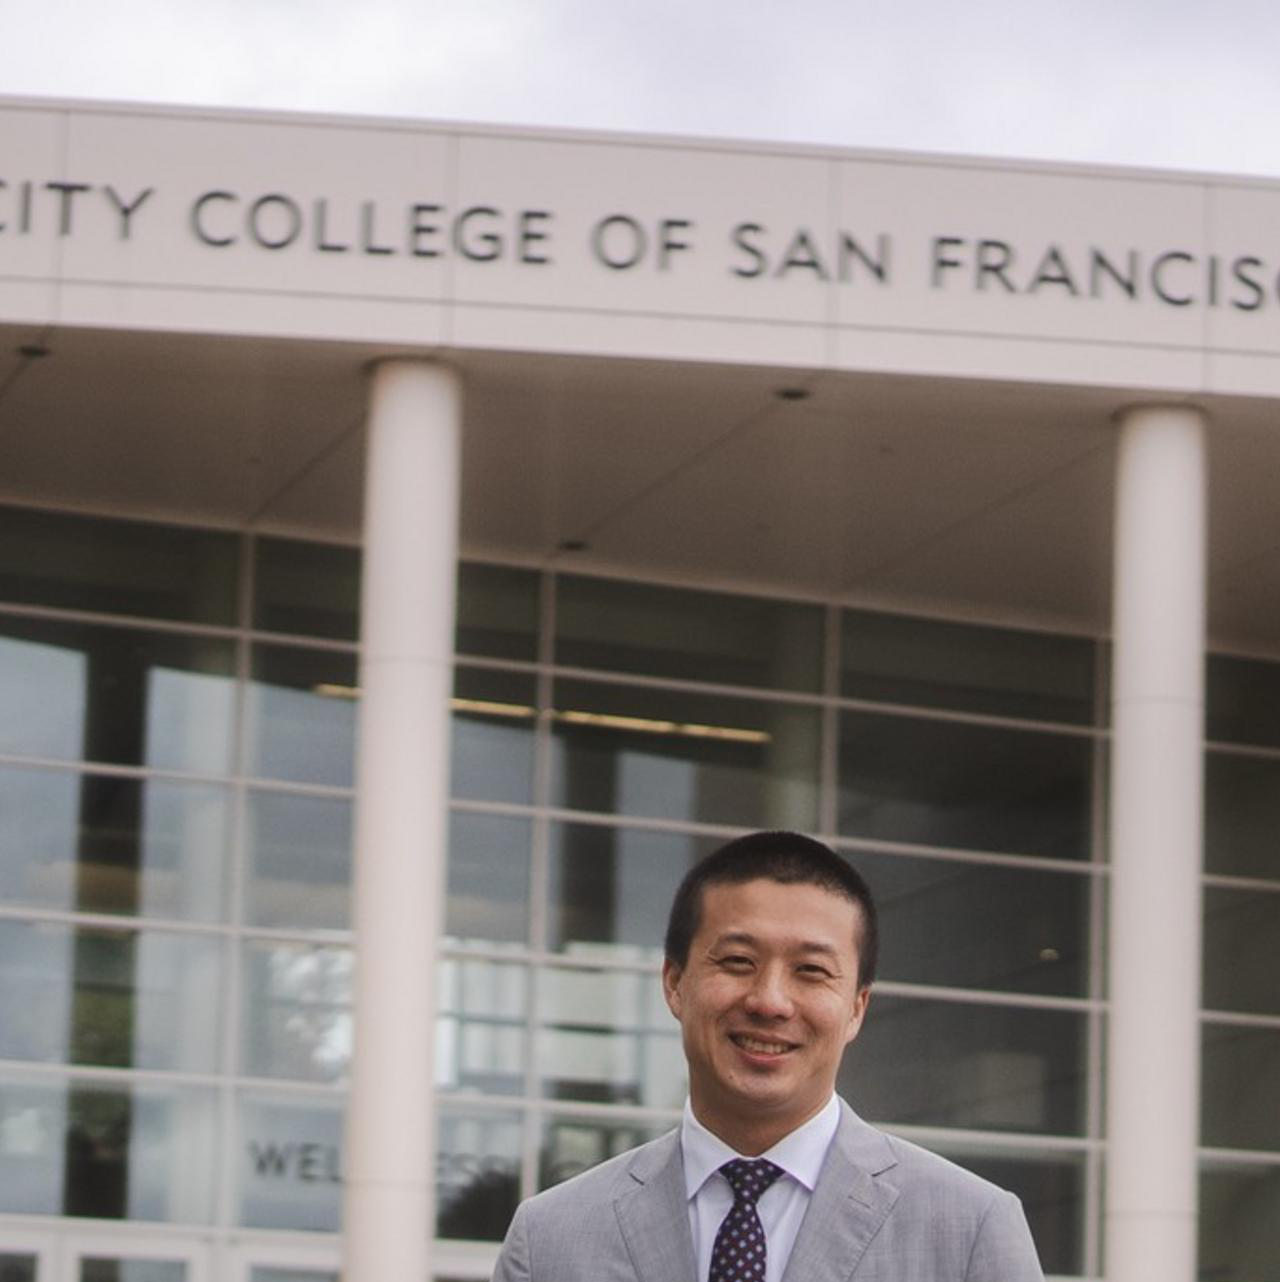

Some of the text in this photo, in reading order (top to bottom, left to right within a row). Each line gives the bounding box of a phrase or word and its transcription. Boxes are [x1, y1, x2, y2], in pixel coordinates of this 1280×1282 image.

[190, 191, 552, 265] COLLEGE
[591, 214, 695, 272] OF
[730, 222, 892, 285] SAN
